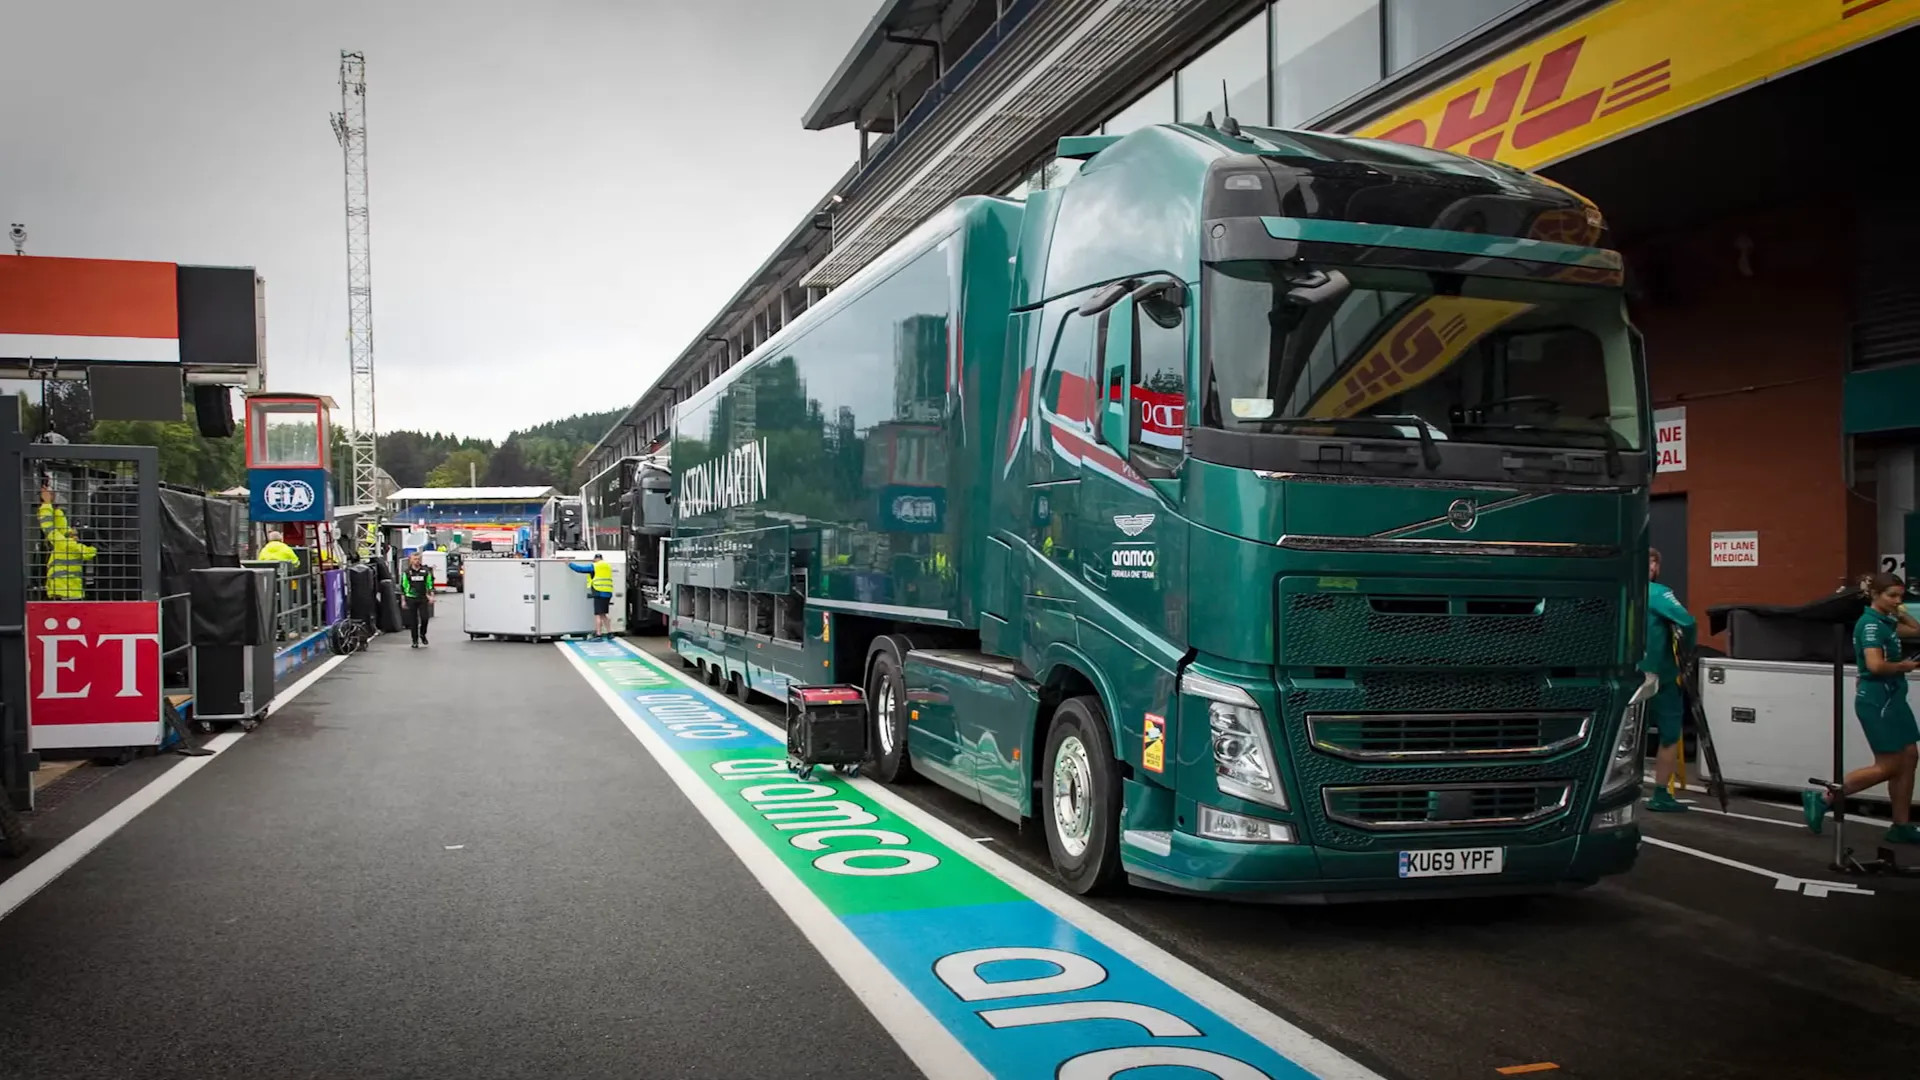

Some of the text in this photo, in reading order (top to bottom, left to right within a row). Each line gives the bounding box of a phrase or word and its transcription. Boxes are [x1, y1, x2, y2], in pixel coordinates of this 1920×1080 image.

[679, 436, 767, 519] ASTON MARTIN
[1714, 541, 1755, 550] PIT LANE
[1111, 550, 1155, 567] aramco
[1714, 553, 1755, 563] MEDICAL
[1111, 569, 1130, 578] FORMULA
[1141, 570, 1155, 579] TEAM
[36, 617, 159, 699] ËT
[636, 693, 749, 740] aramco
[710, 758, 942, 877] aramco
[1407, 850, 1494, 872] KU69 YPF
